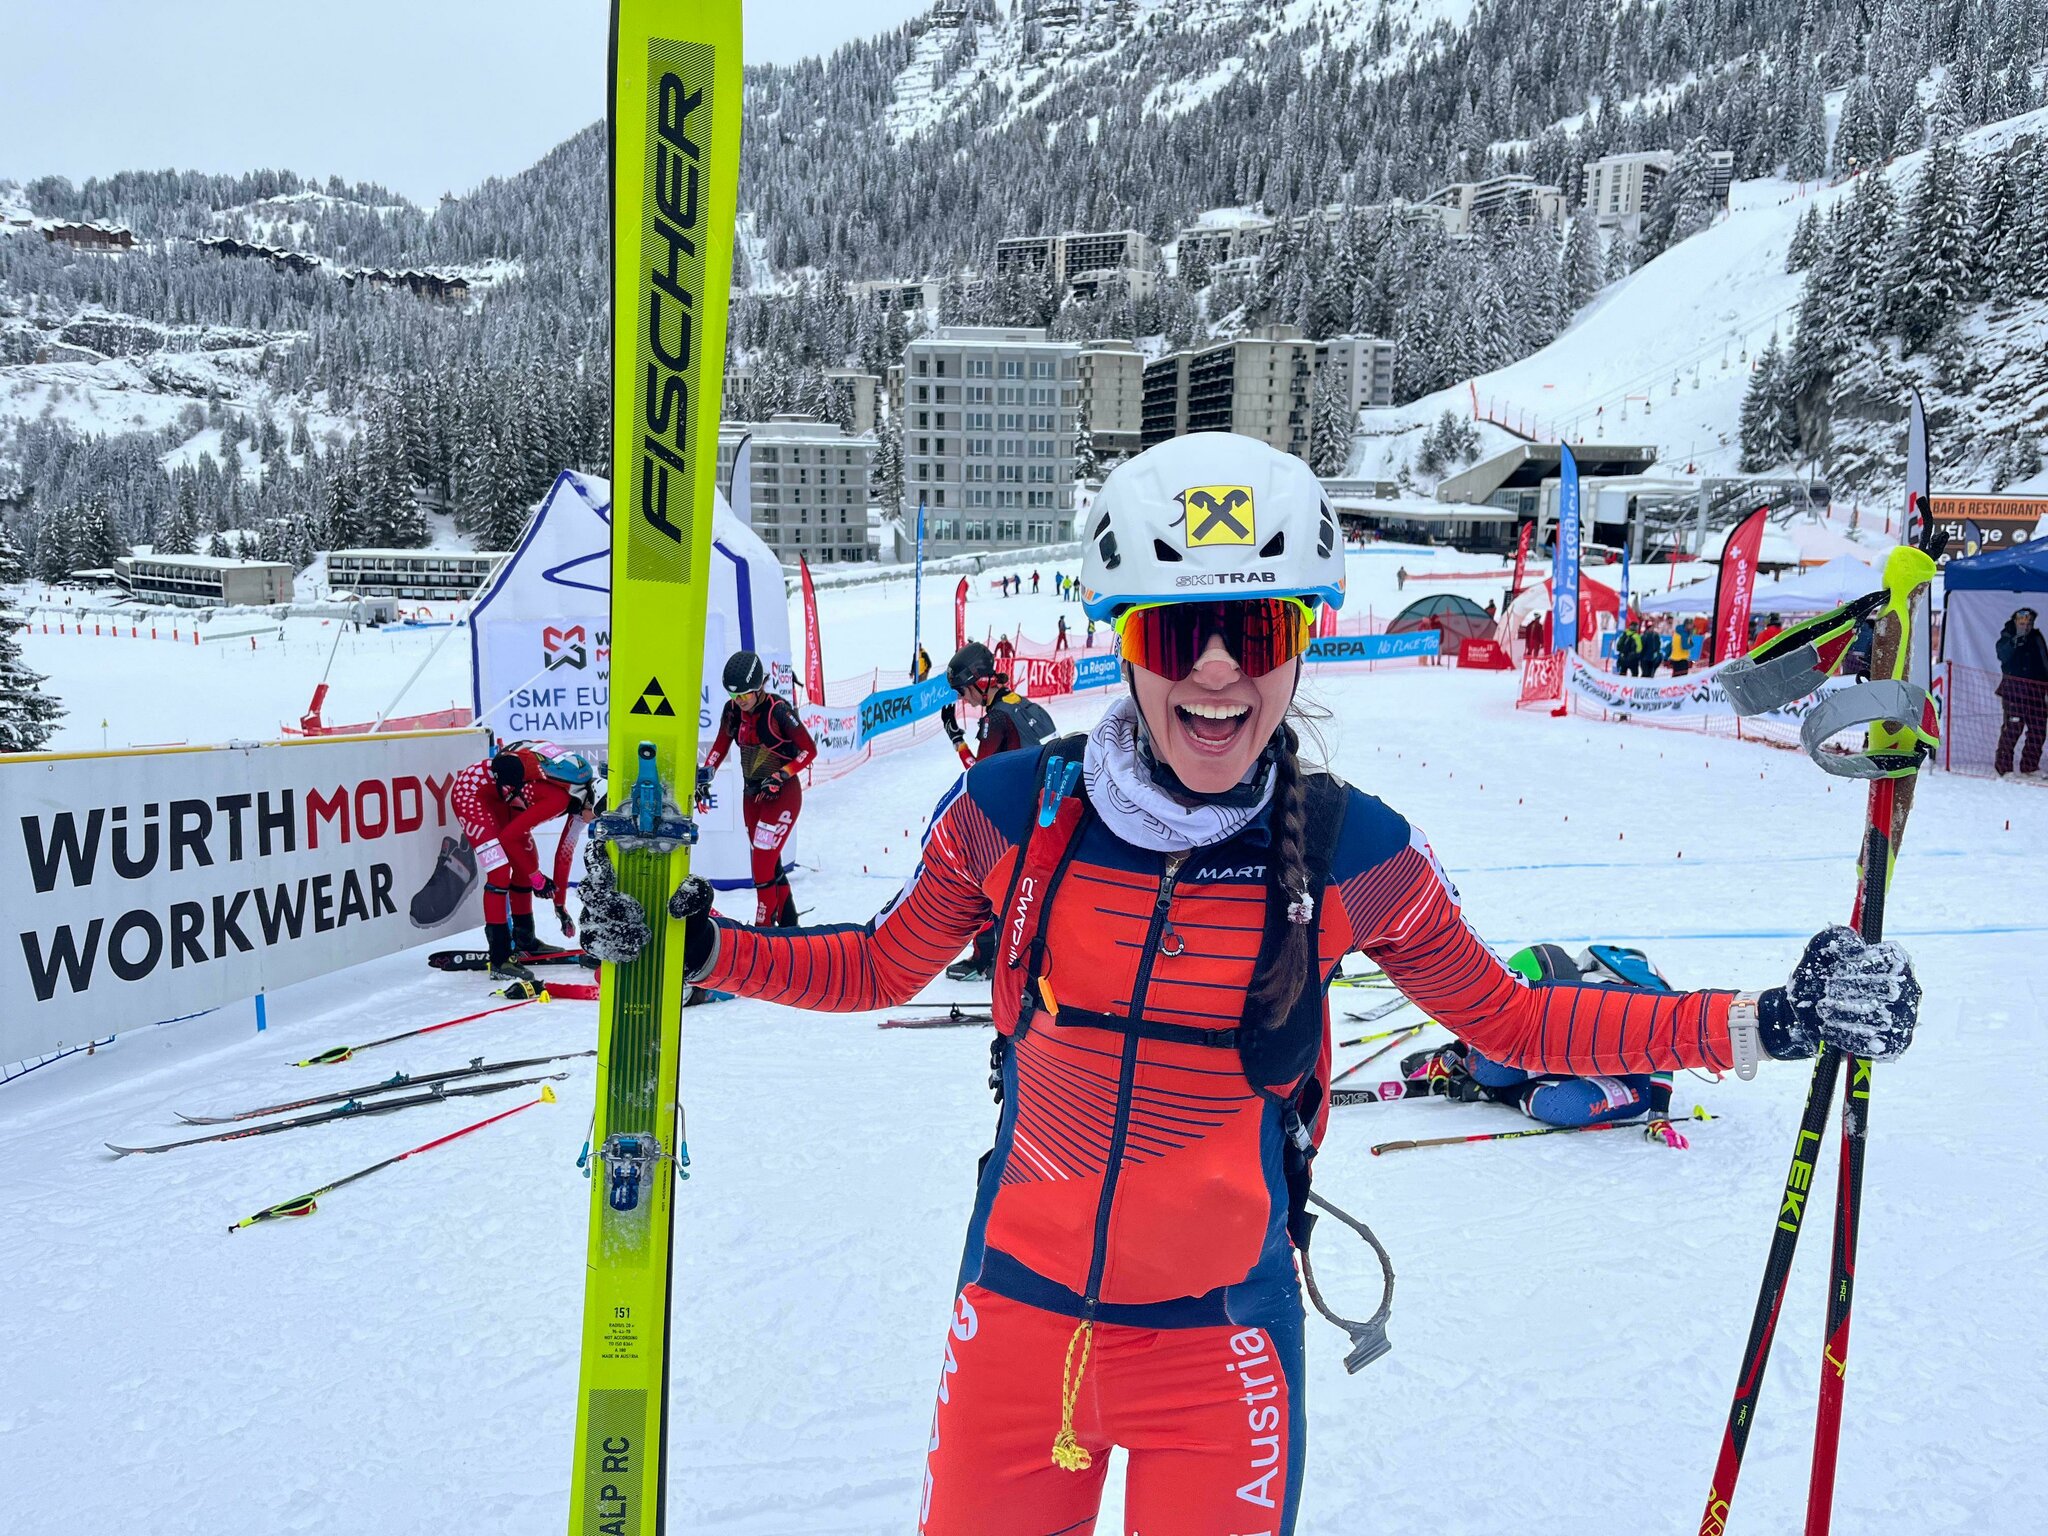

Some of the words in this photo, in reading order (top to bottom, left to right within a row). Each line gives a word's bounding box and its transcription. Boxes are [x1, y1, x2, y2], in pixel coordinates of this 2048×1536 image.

[642, 71, 703, 545] FISCHER
[1933, 501, 1955, 514] BAR
[1968, 501, 2048, 516] RESTAURANTS
[1305, 641, 1365, 657] ARPA
[1029, 660, 1058, 686] ATK
[1080, 664, 1089, 675] La
[1089, 659, 1116, 675] Région
[509, 687, 567, 709] ISMF
[21, 788, 297, 894] WÜRTH
[306, 772, 462, 850] MODY
[459, 816, 485, 840] SUI
[1196, 864, 1267, 881] MART
[1012, 877, 1034, 946] CAMP
[20, 862, 398, 1002] WORKWEAR
[464, 952, 490, 961] RAB
[1852, 1058, 1872, 1099] KI
[1778, 1128, 1820, 1233] LEKI
[1839, 1279, 1848, 1302] HRC
[614, 1306, 631, 1319] 151
[1226, 1328, 1280, 1510] Austria
[1737, 1404, 1748, 1427] HRC
[602, 1436, 630, 1473] RC
